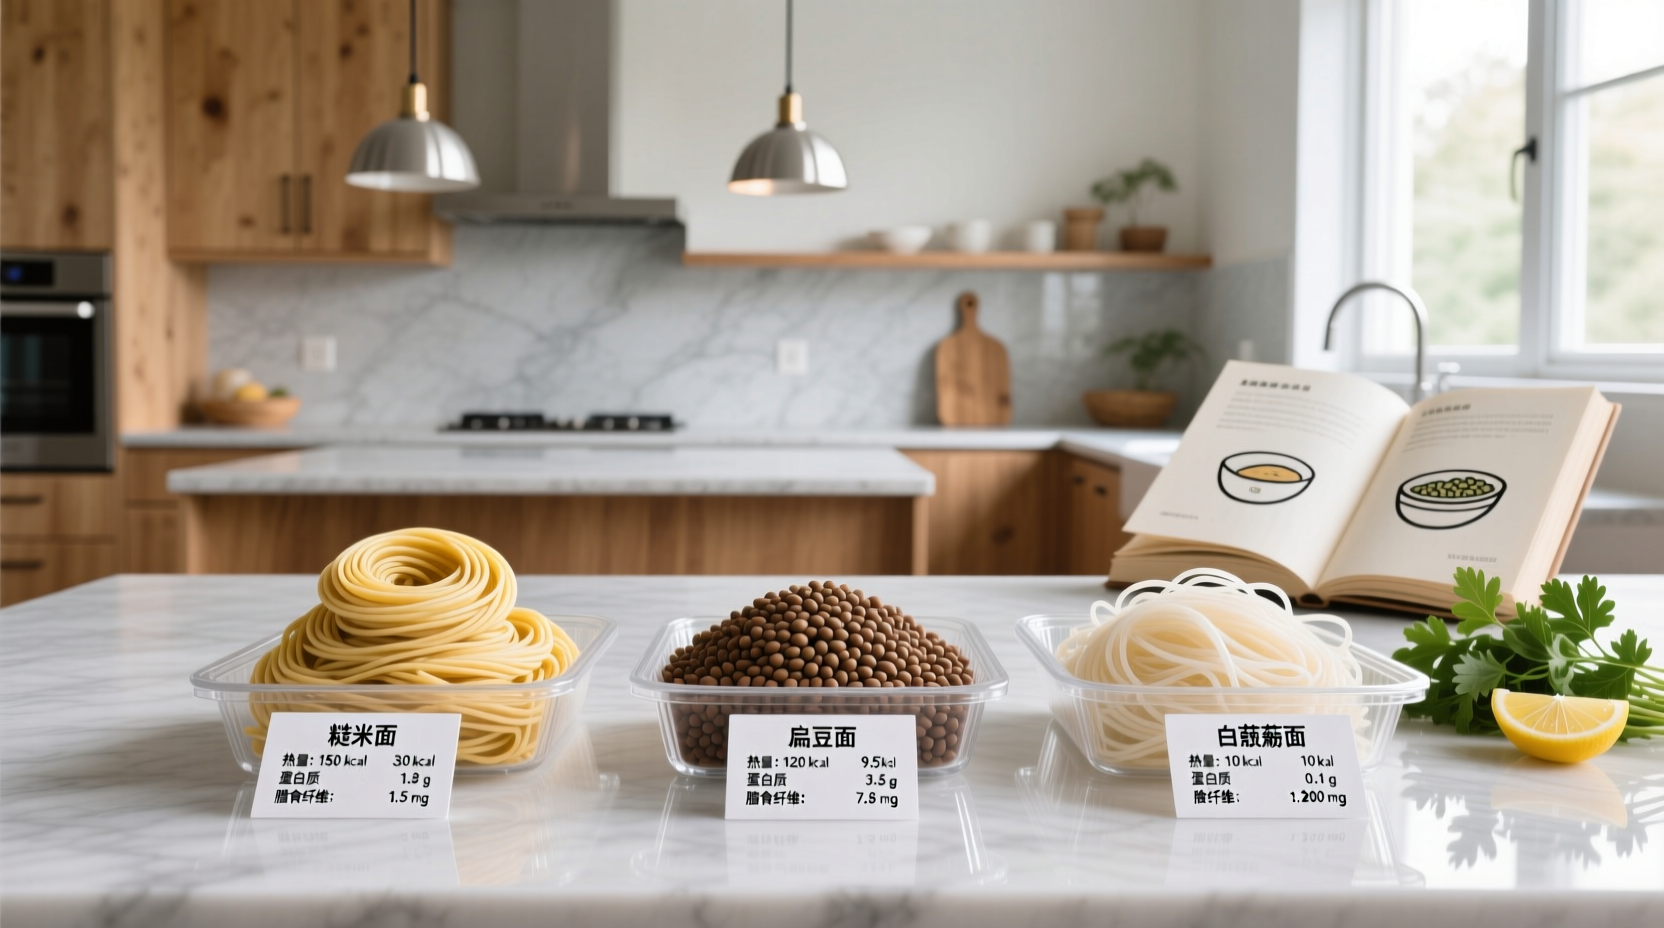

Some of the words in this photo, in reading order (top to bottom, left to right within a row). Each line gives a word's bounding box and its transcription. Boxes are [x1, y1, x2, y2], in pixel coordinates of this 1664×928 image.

[328, 723, 397, 747] 糙米面
[788, 725, 856, 748] 扁豆面
[320, 754, 341, 766] 150
[344, 755, 367, 767] kcal
[393, 754, 410, 767] 30
[783, 756, 805, 768] 120
[1225, 755, 1240, 767] 10
[1301, 755, 1315, 767] 10
[423, 777, 430, 788] g
[866, 774, 886, 786] 3.5
[889, 778, 897, 789] g
[1305, 773, 1324, 785] 0.1
[1329, 776, 1336, 788] g
[389, 791, 408, 803] 1.5
[411, 794, 429, 807] mg
[880, 795, 898, 809] mg
[1328, 794, 1346, 808] mg
